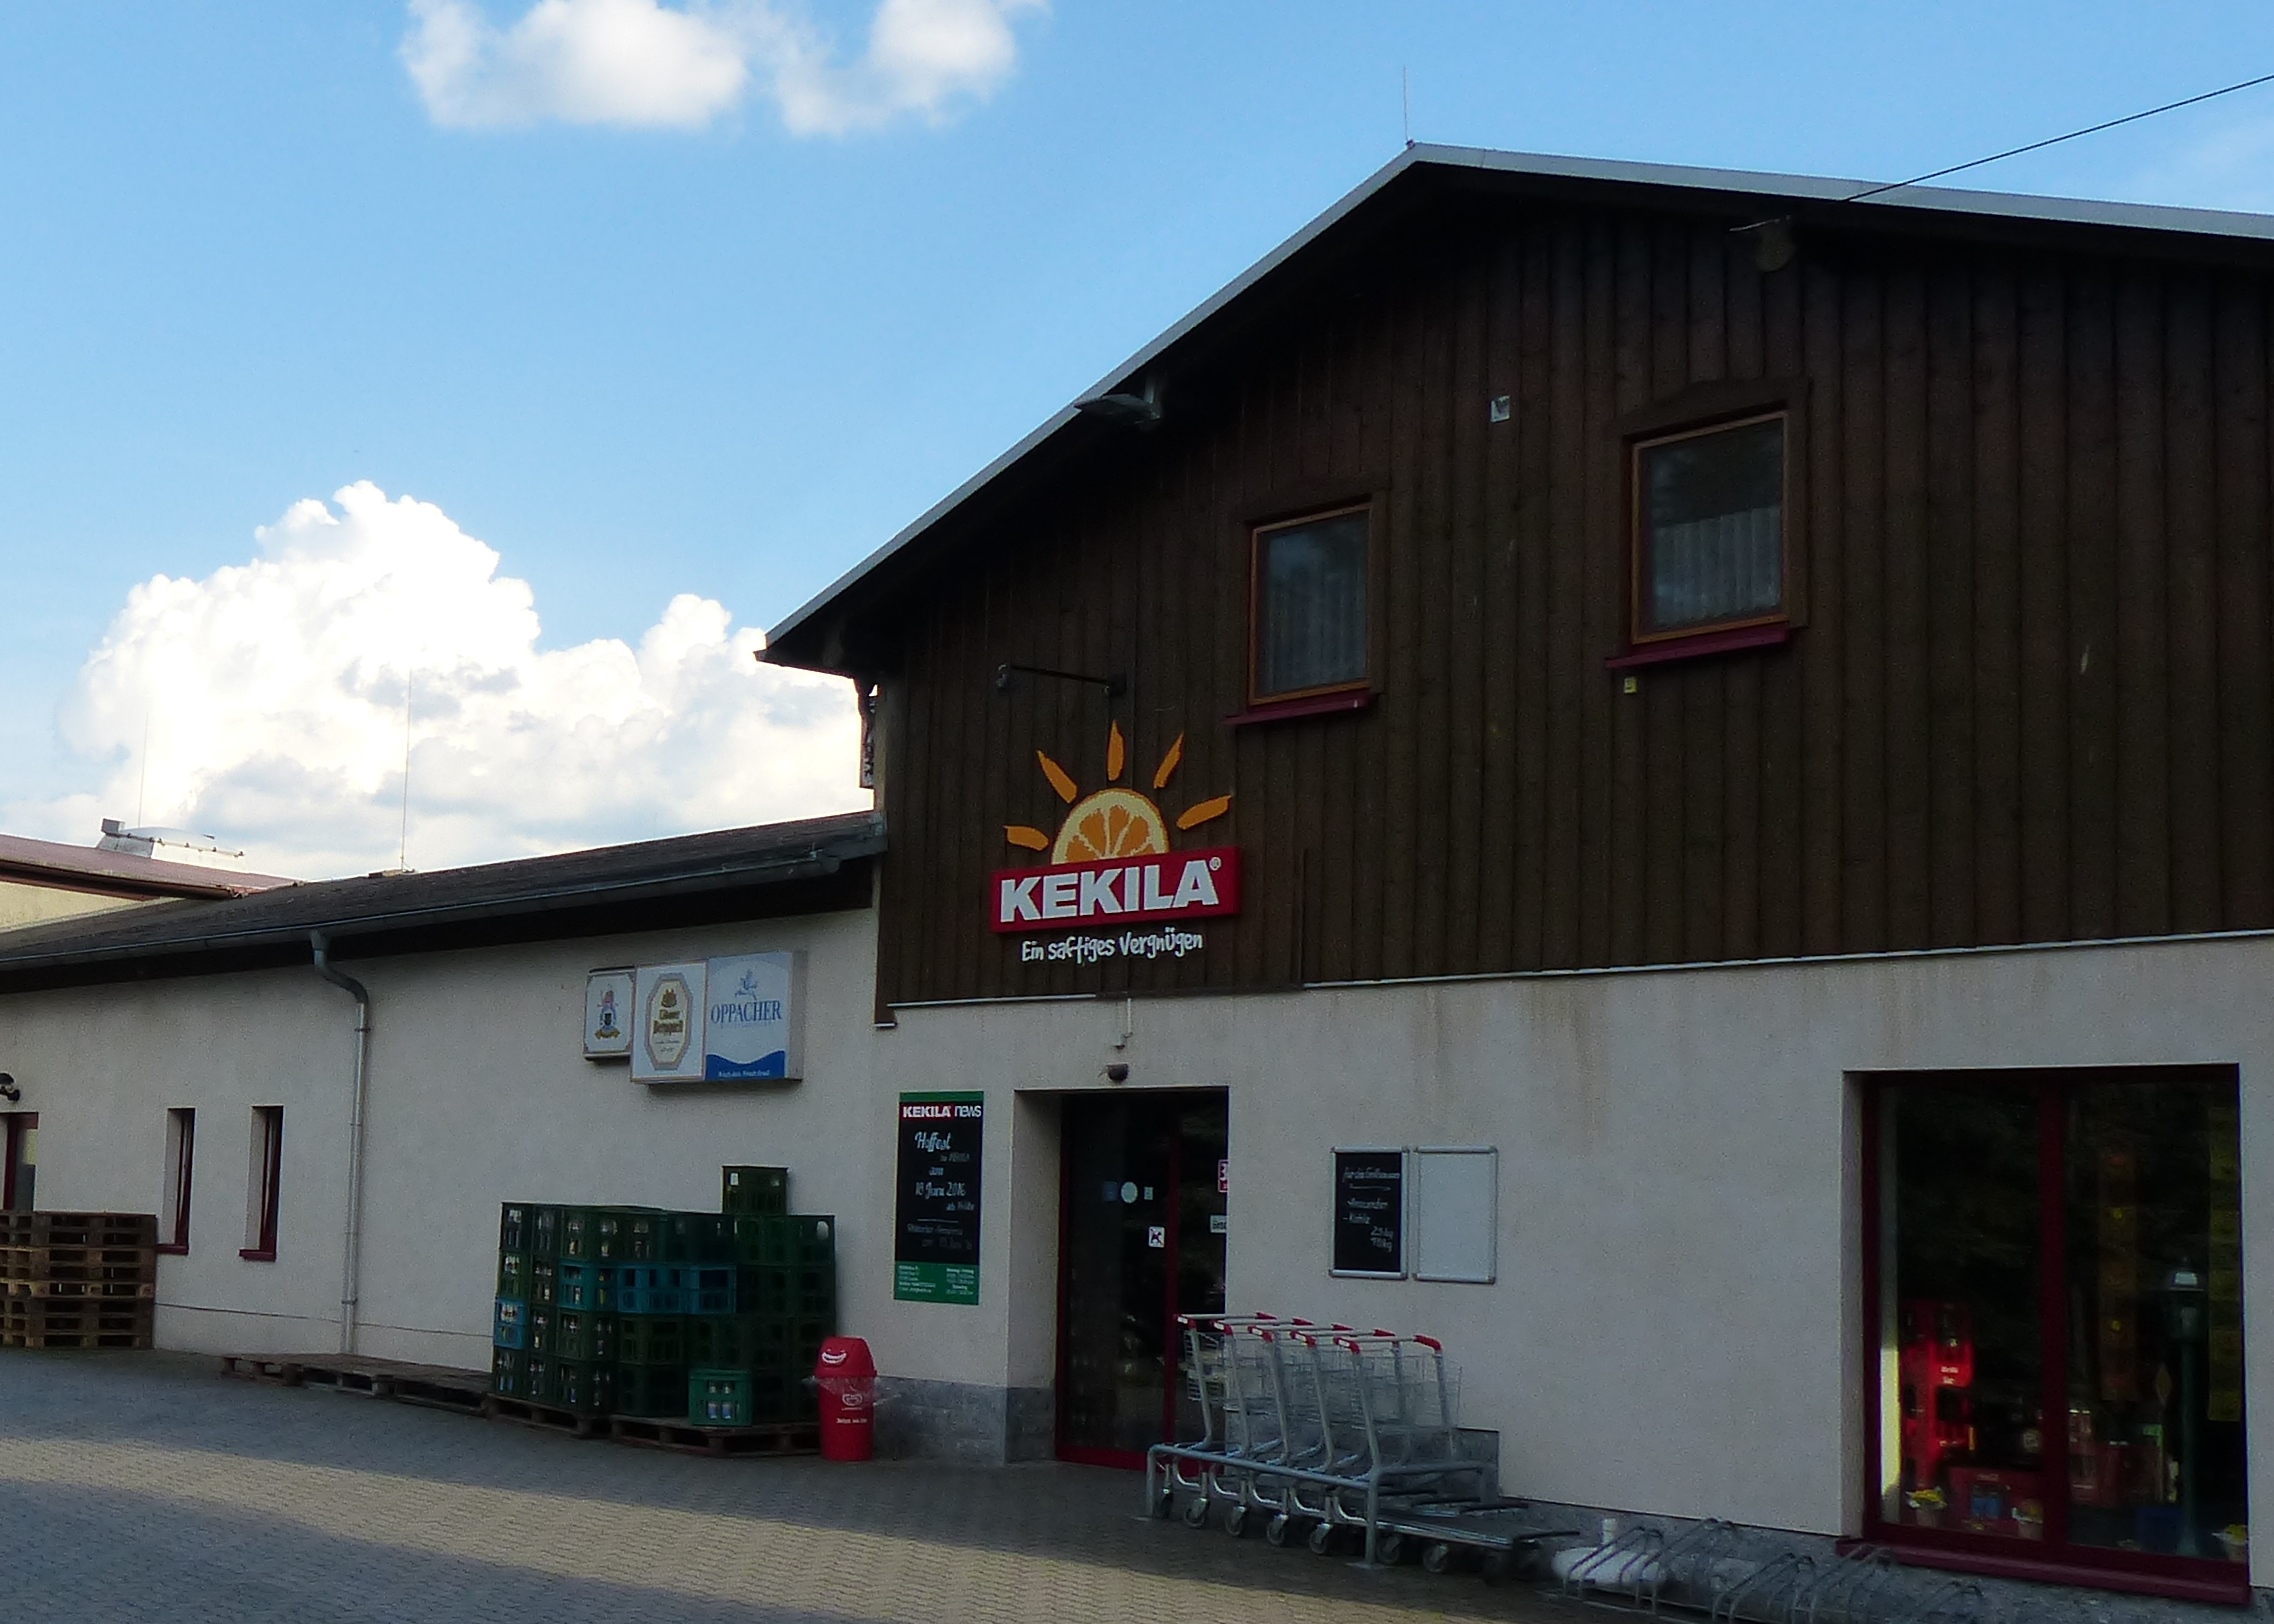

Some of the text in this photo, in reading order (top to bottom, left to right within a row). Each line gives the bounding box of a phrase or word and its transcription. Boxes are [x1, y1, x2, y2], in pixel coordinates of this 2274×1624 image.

[1000, 859, 1219, 923] KEKILA
[1021, 927, 1203, 964] Ein saftiges Vergnügen
[710, 1000, 782, 1024] OPPACHER
[902, 1105, 982, 1118] KEKILA news
